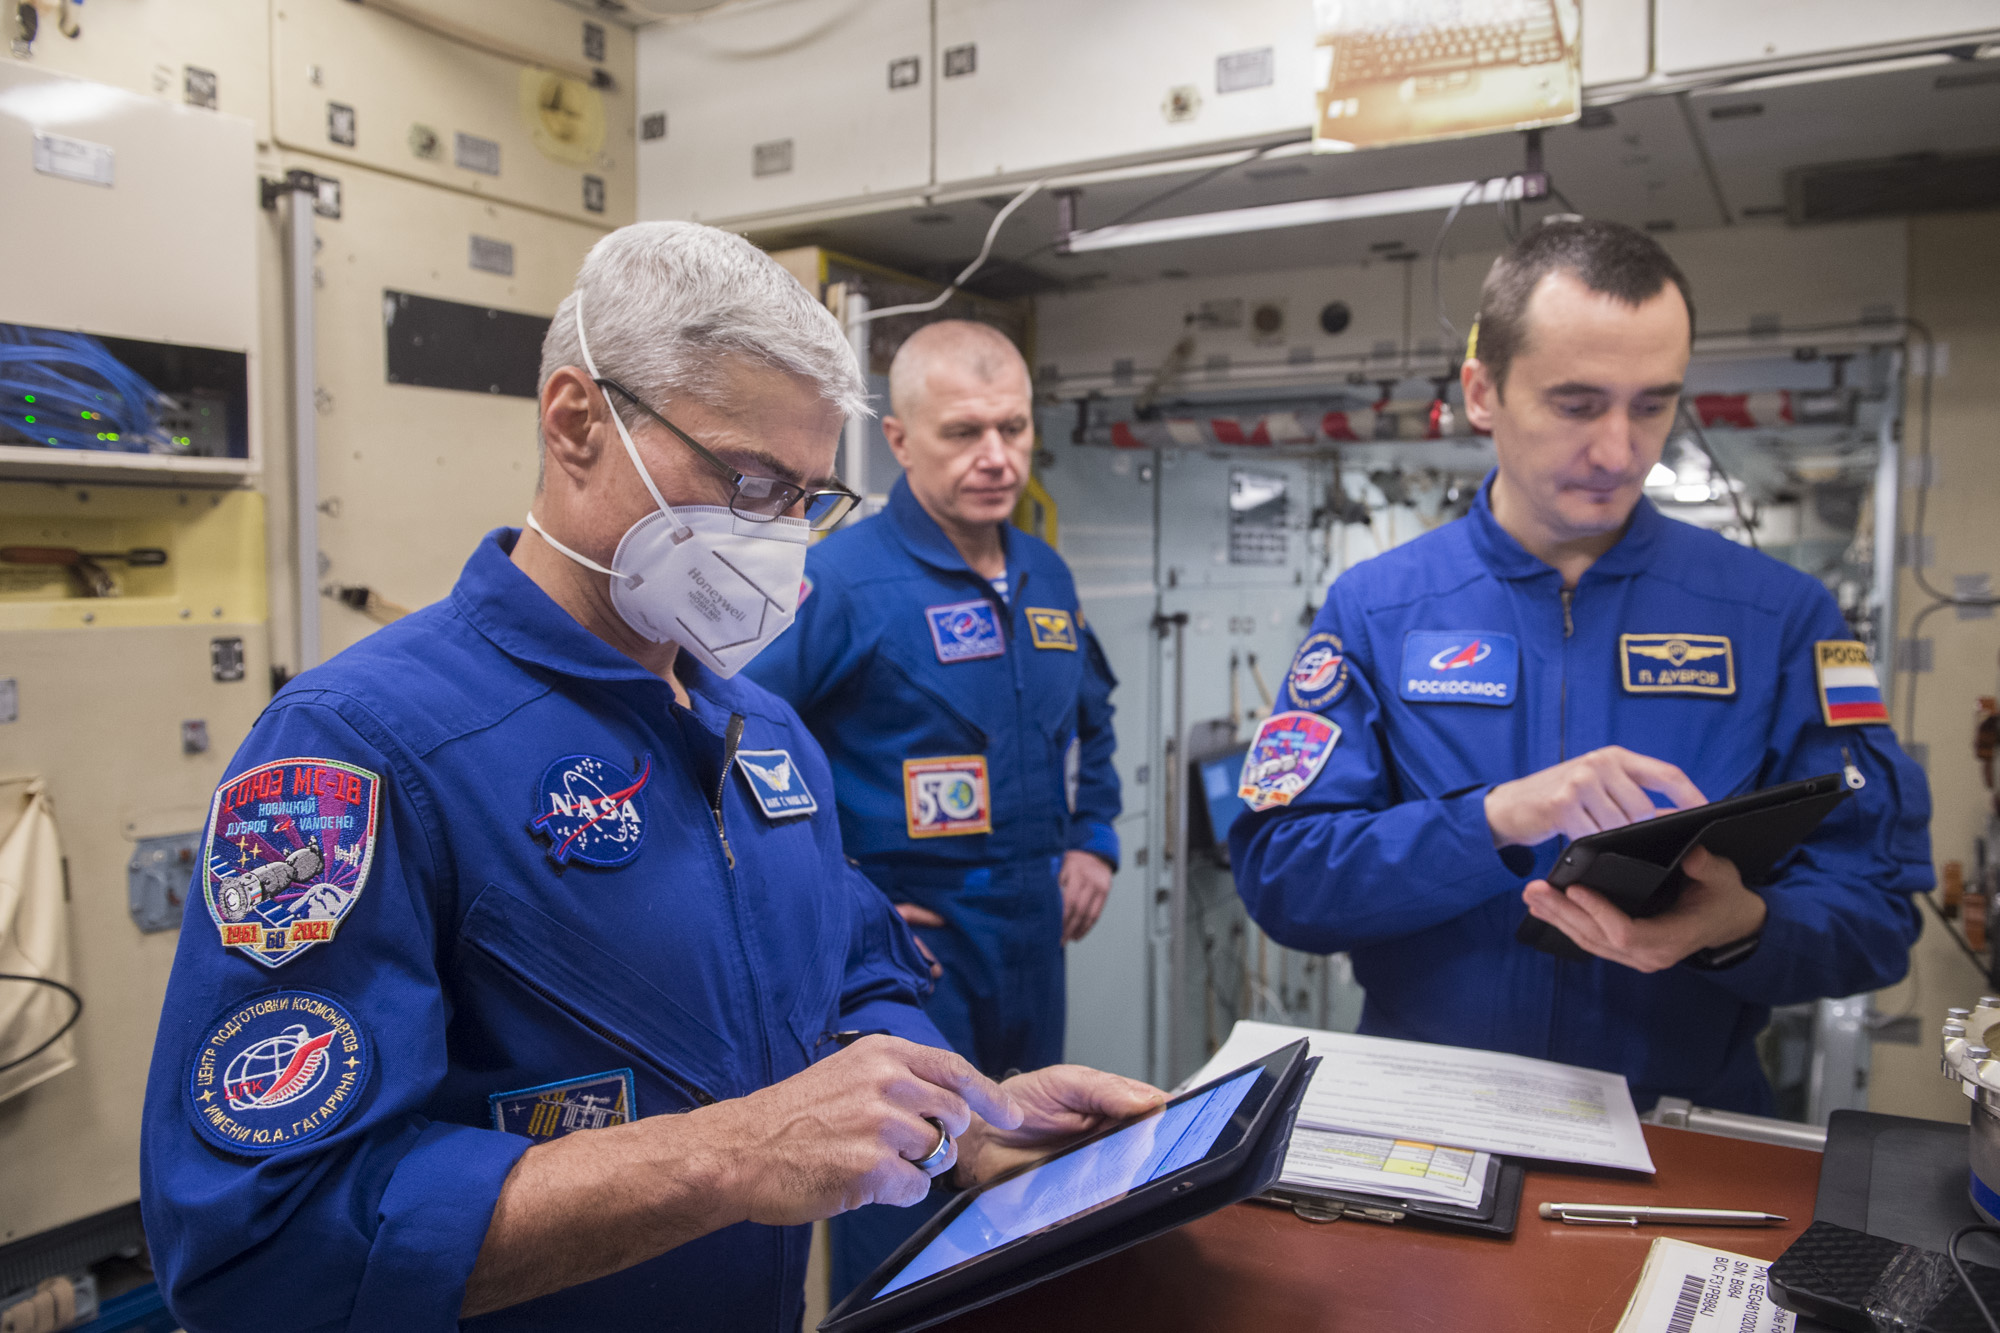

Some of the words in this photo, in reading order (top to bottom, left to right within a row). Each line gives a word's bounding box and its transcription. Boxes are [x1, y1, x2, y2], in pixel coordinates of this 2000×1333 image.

[687, 567, 747, 622] Honeywell
[707, 609, 721, 623] N95
[1658, 669, 1719, 685] ДУБРОВ
[1407, 679, 1507, 698] РОСКОСМОС
[224, 769, 284, 814] СОЮЗ
[258, 796, 316, 817] НОВИЦКИЙ
[550, 792, 642, 823] NASA
[225, 819, 268, 837] ДУБРОВ
[226, 924, 257, 945] 1961
[266, 930, 285, 949] 60
[293, 920, 329, 941] 2021
[198, 1048, 217, 1086] ЦЕНТР
[212, 997, 289, 1047] ПОДГОТОВКИ
[292, 997, 359, 1053] КОСМОНАВТОВ
[224, 1079, 265, 1101] ЦПК
[203, 1104, 251, 1142] ИМЕНИ
[292, 1071, 357, 1135] ГАГАРИНА
[1712, 1256, 1729, 1273] B/C:
[1732, 1261, 1748, 1277] S/N:
[1752, 1265, 1768, 1282] P/N:
[1700, 1273, 1724, 1317] F31PB984J
[1727, 1278, 1744, 1299] B984
